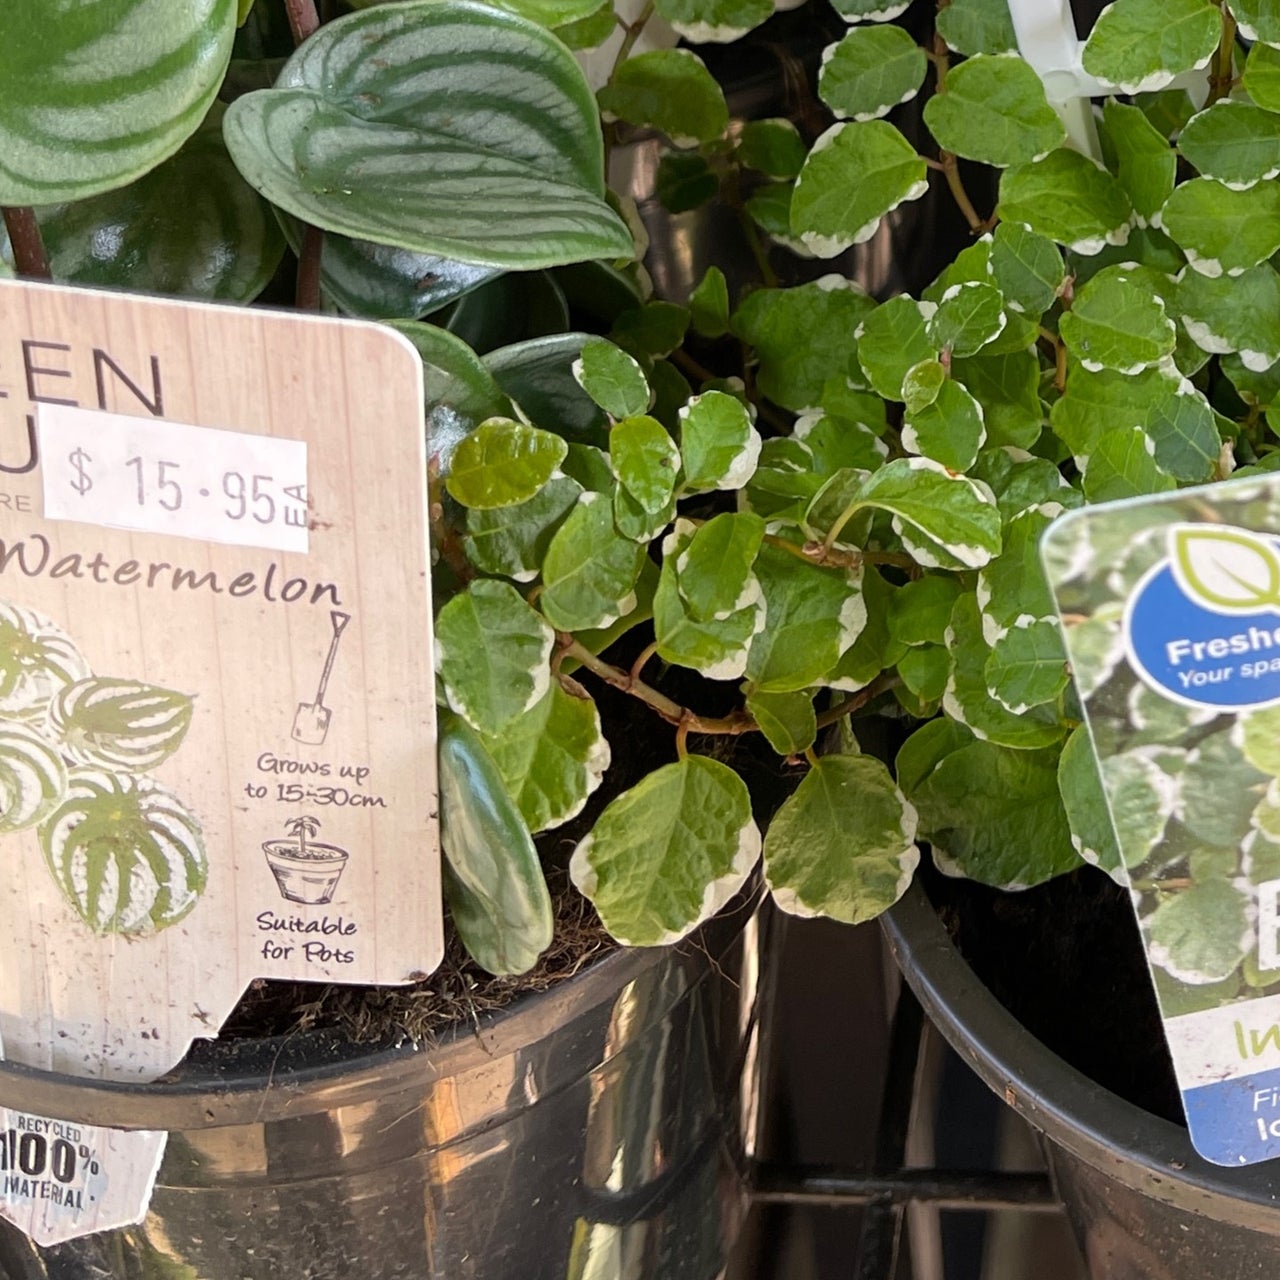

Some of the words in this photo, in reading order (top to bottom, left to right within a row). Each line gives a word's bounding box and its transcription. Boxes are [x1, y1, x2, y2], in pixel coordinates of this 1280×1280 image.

[0, 339, 164, 417] EN
[69, 446, 93, 496] $
[0, 533, 341, 605] Watermelon
[1177, 665, 1234, 689] Your
[257, 752, 331, 777] Grows
[339, 766, 370, 786] up
[244, 782, 268, 799] to
[276, 783, 388, 808] 15-30cm
[256, 911, 358, 936] Suitable
[261, 940, 294, 961] for
[302, 941, 355, 963] Pots
[18, 1116, 81, 1143] RECYCLED
[4, 1176, 84, 1210] MATERIAL
